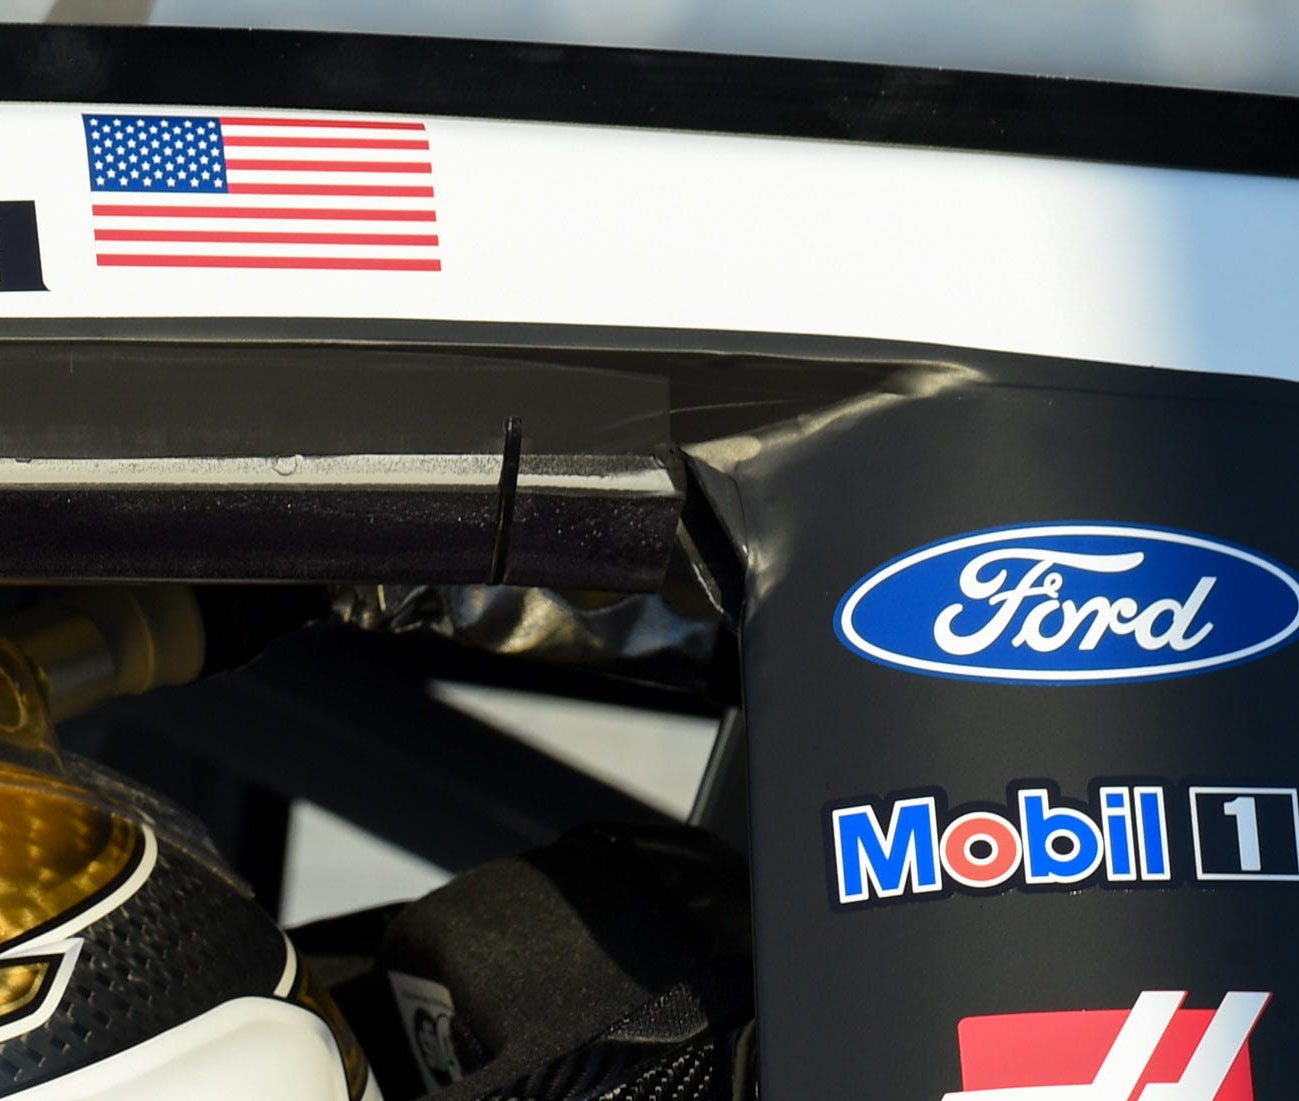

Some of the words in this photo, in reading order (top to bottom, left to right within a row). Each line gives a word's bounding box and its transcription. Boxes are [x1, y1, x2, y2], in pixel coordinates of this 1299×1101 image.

[933, 547, 1218, 656] Ford
[831, 785, 1171, 904] Mobil
[1223, 796, 1263, 872] 1
